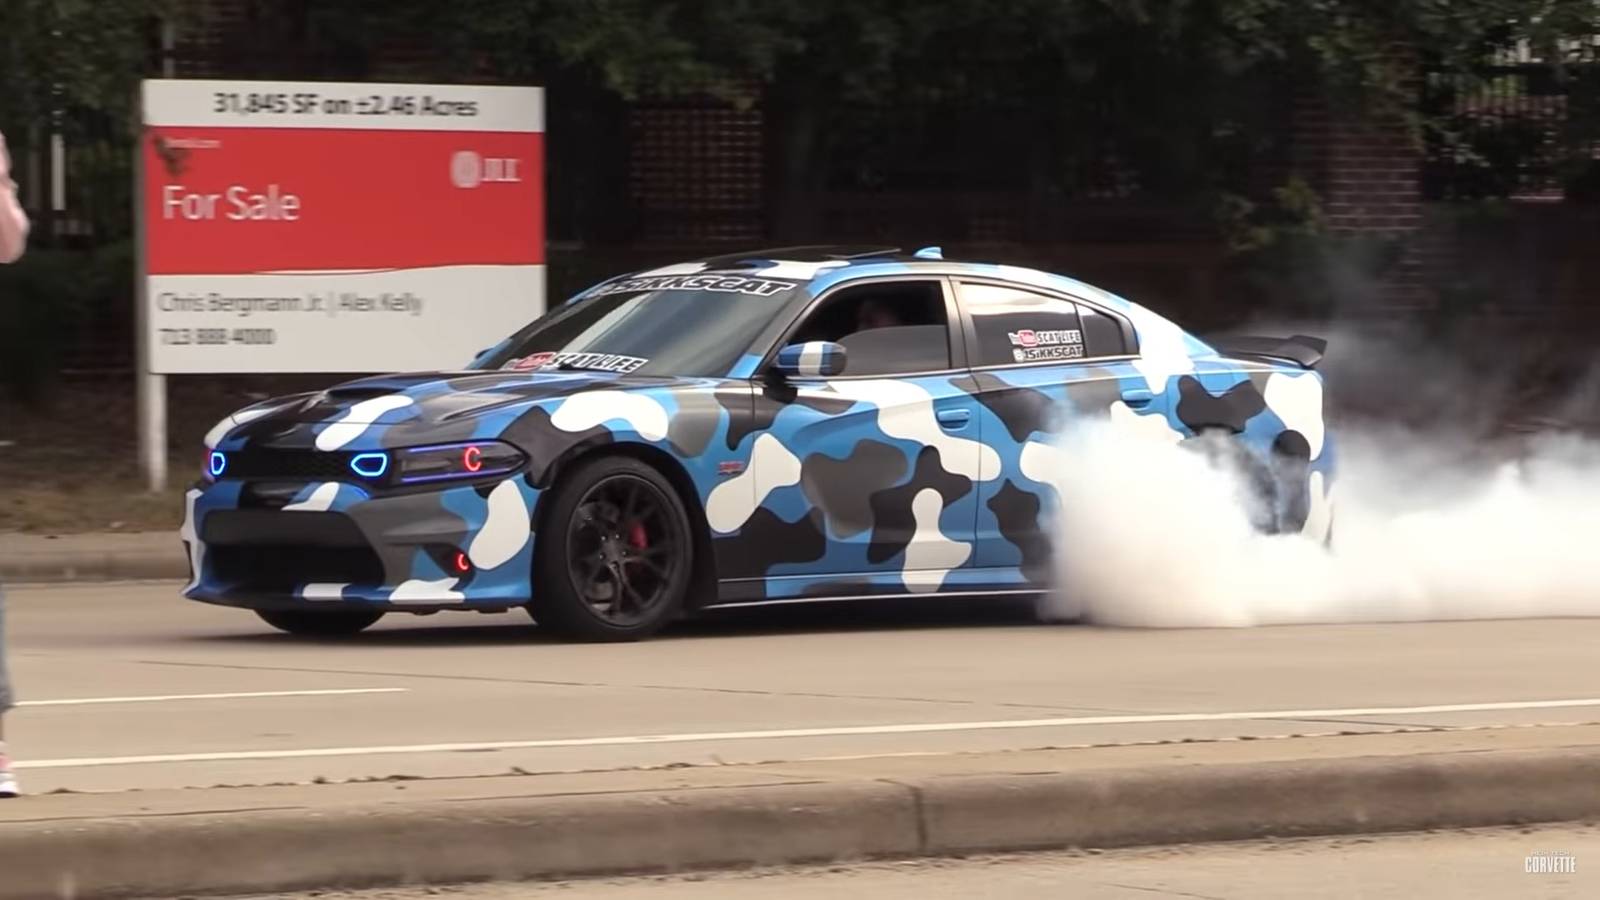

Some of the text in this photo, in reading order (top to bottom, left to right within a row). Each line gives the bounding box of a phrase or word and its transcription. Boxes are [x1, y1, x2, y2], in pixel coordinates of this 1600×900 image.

[213, 92, 288, 115] 31,845
[292, 93, 318, 113] SF
[323, 98, 353, 114] on
[420, 96, 478, 116] Acres
[163, 184, 301, 221] For Sale
[157, 292, 204, 312] Chris
[208, 293, 302, 317] Bergmann
[340, 293, 377, 312] Alex
[379, 291, 424, 317] Kelly
